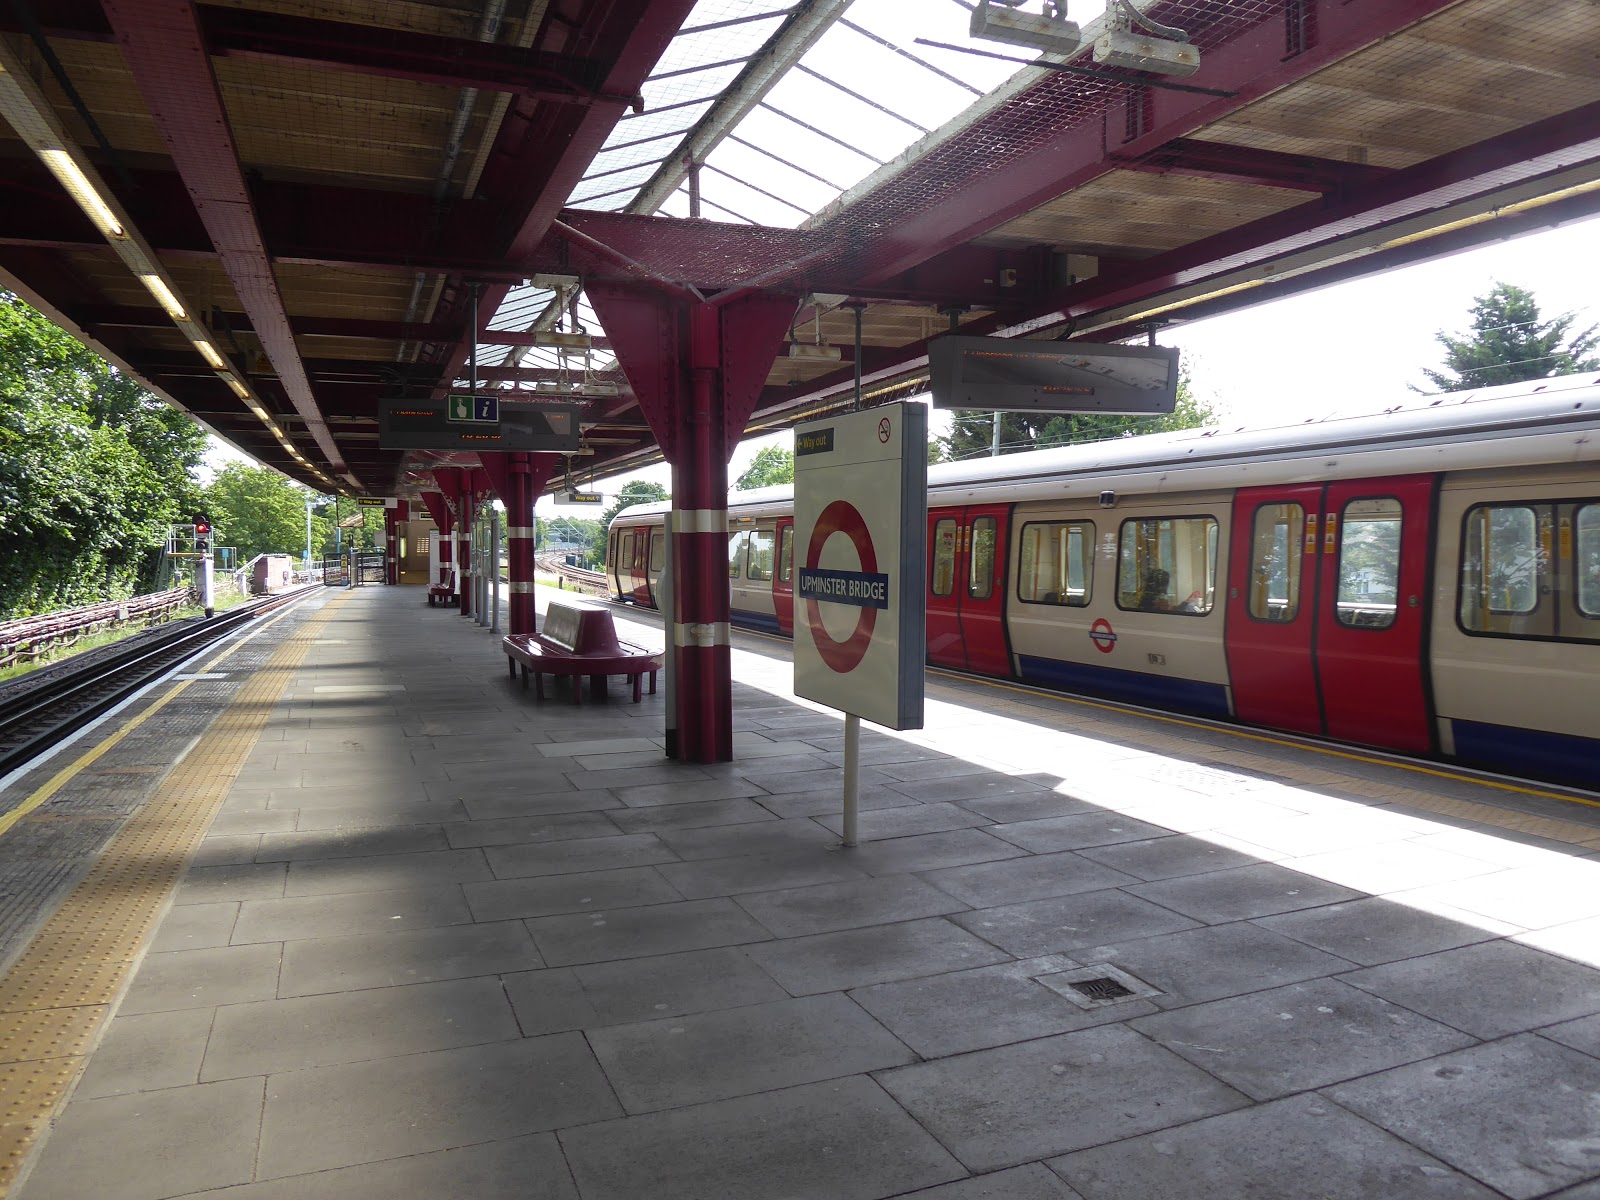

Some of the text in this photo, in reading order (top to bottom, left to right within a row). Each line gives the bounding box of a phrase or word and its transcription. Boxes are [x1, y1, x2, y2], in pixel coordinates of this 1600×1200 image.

[803, 434, 826, 449] Way out
[801, 575, 885, 600] UPMINSTER BRIDGE
